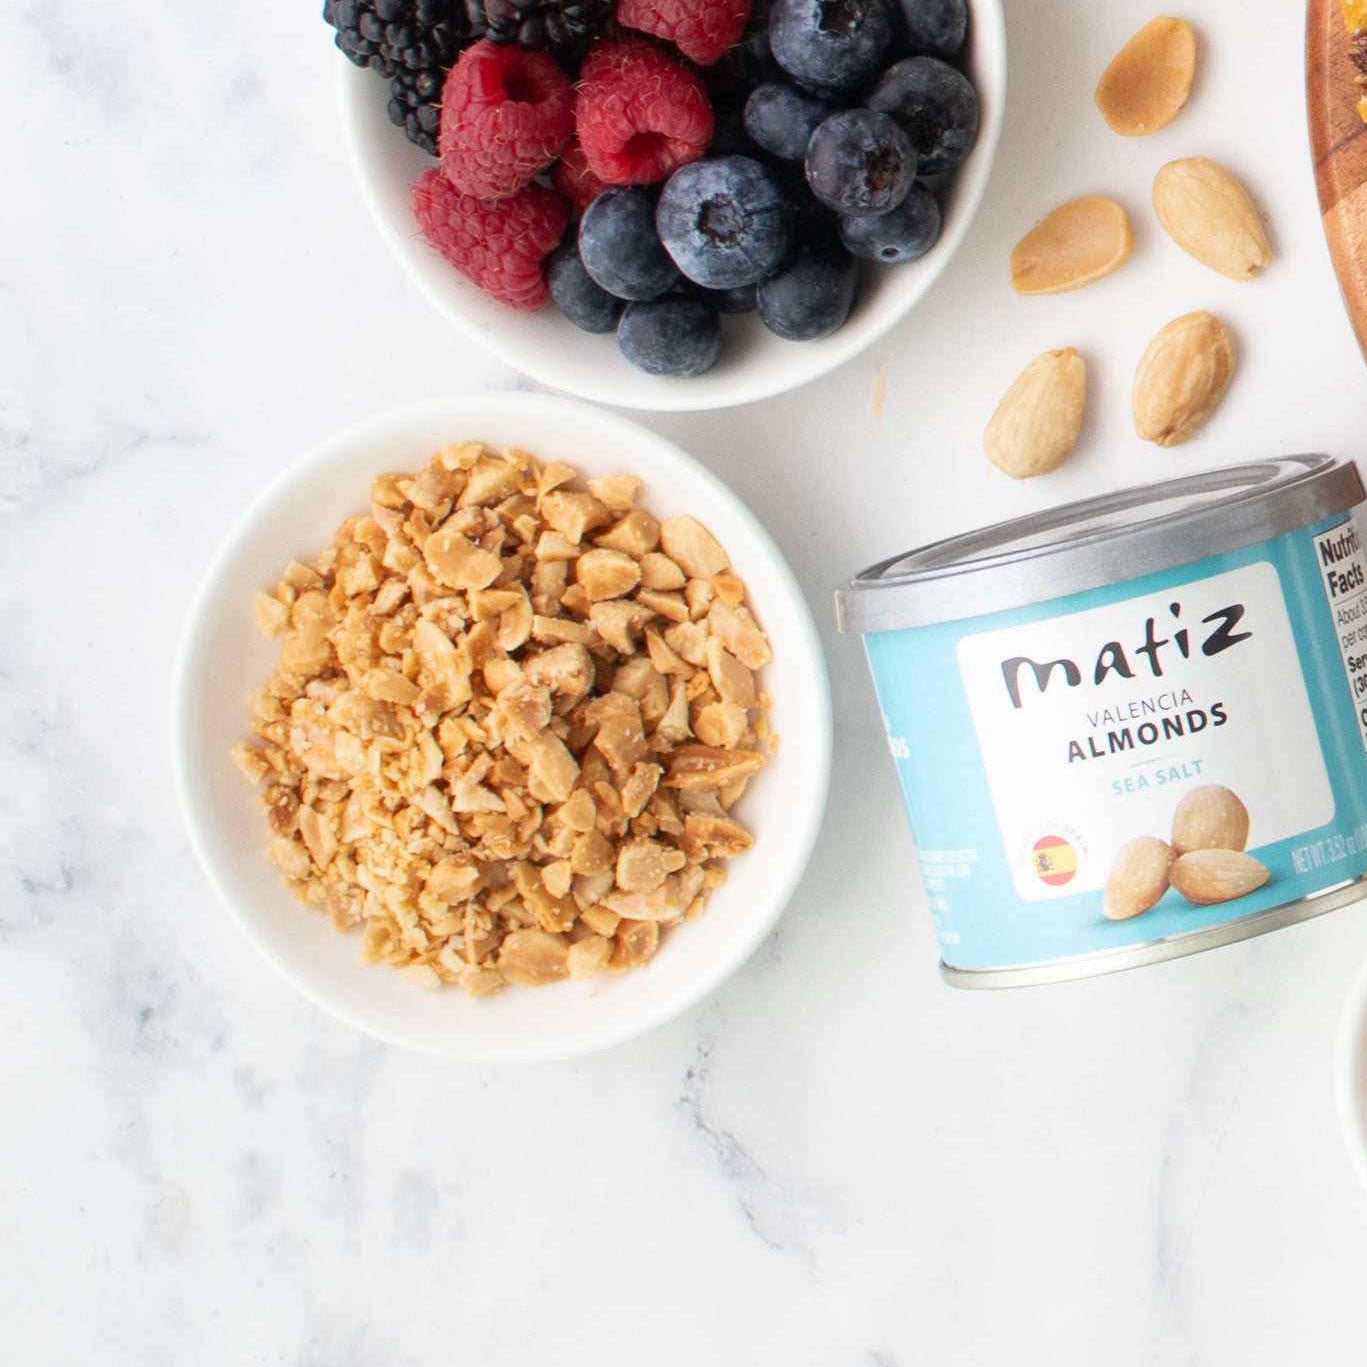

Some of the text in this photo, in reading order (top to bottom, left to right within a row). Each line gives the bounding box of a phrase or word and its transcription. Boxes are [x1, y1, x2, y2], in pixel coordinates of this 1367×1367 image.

[1327, 562, 1364, 597] Facts
[1337, 603, 1361, 626] About
[1001, 602, 1253, 709] matiz
[1087, 688, 1194, 728] VALENCIA
[1068, 702, 1228, 763] ALMONDS
[1112, 759, 1203, 796] SEA SALT
